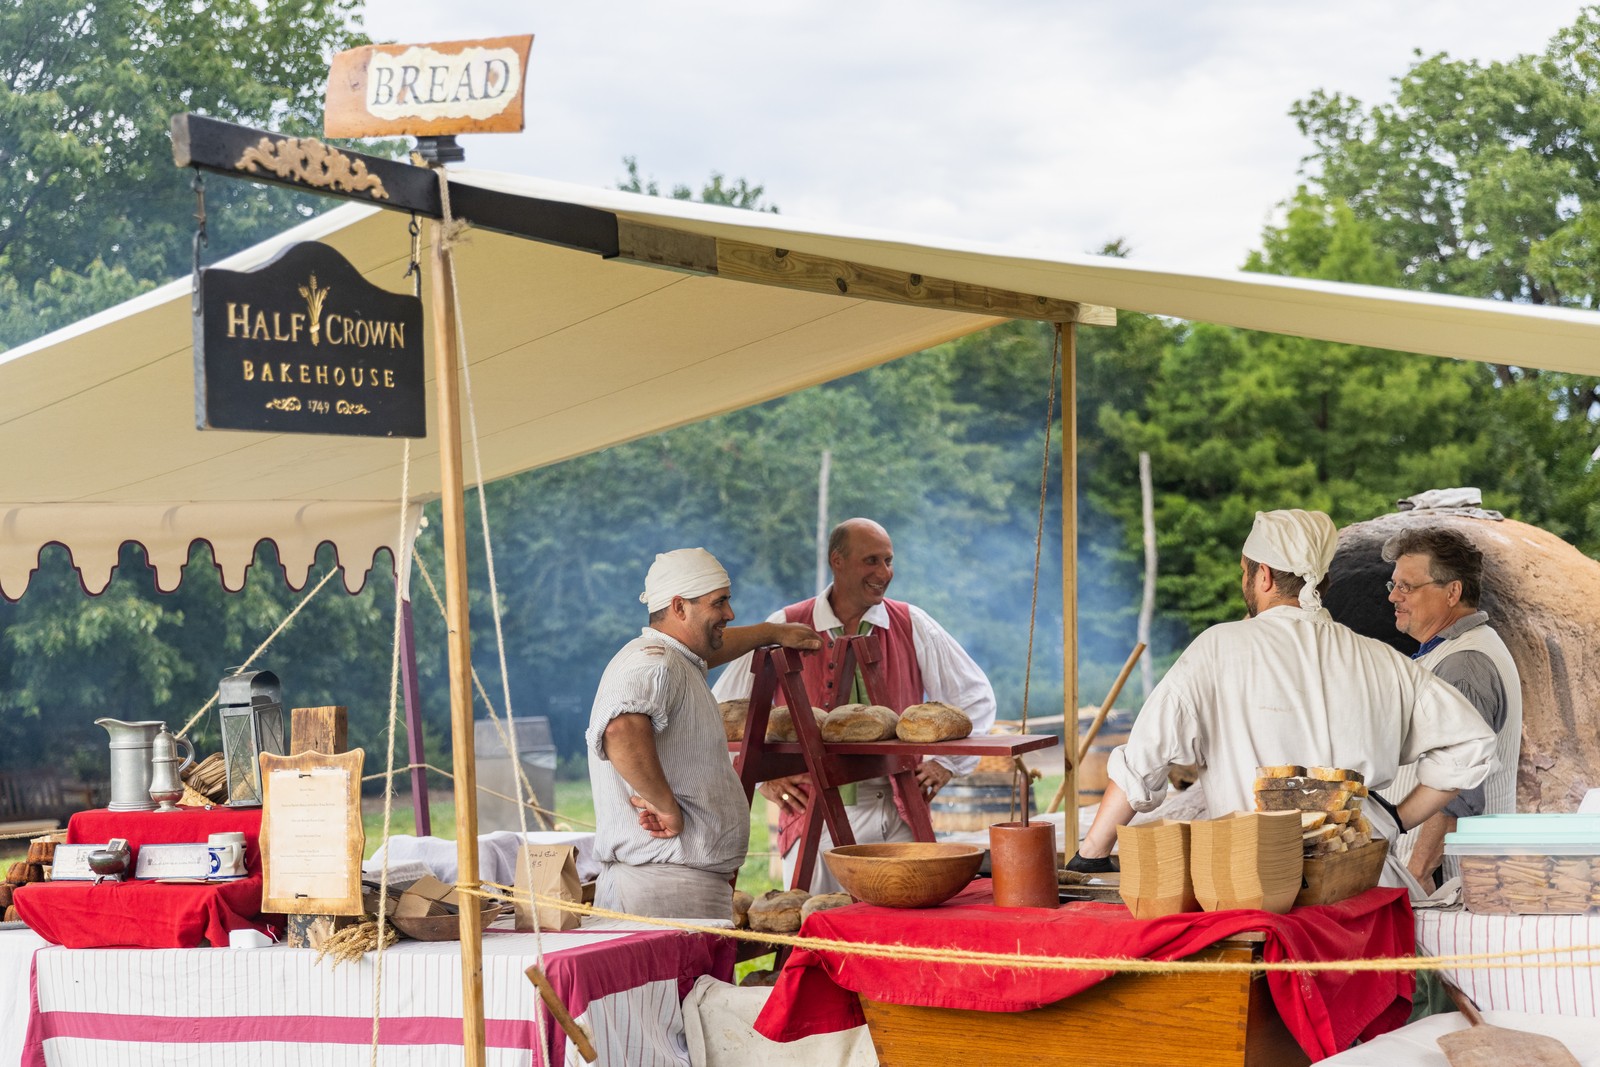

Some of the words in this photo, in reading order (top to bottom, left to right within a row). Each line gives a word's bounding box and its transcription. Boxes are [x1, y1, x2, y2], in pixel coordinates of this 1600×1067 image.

[372, 58, 510, 106] BREAD
[227, 302, 306, 342] HALF
[325, 314, 405, 349] CROWN
[243, 360, 395, 388] BAKEHOUSE
[308, 400, 330, 414] 1749
